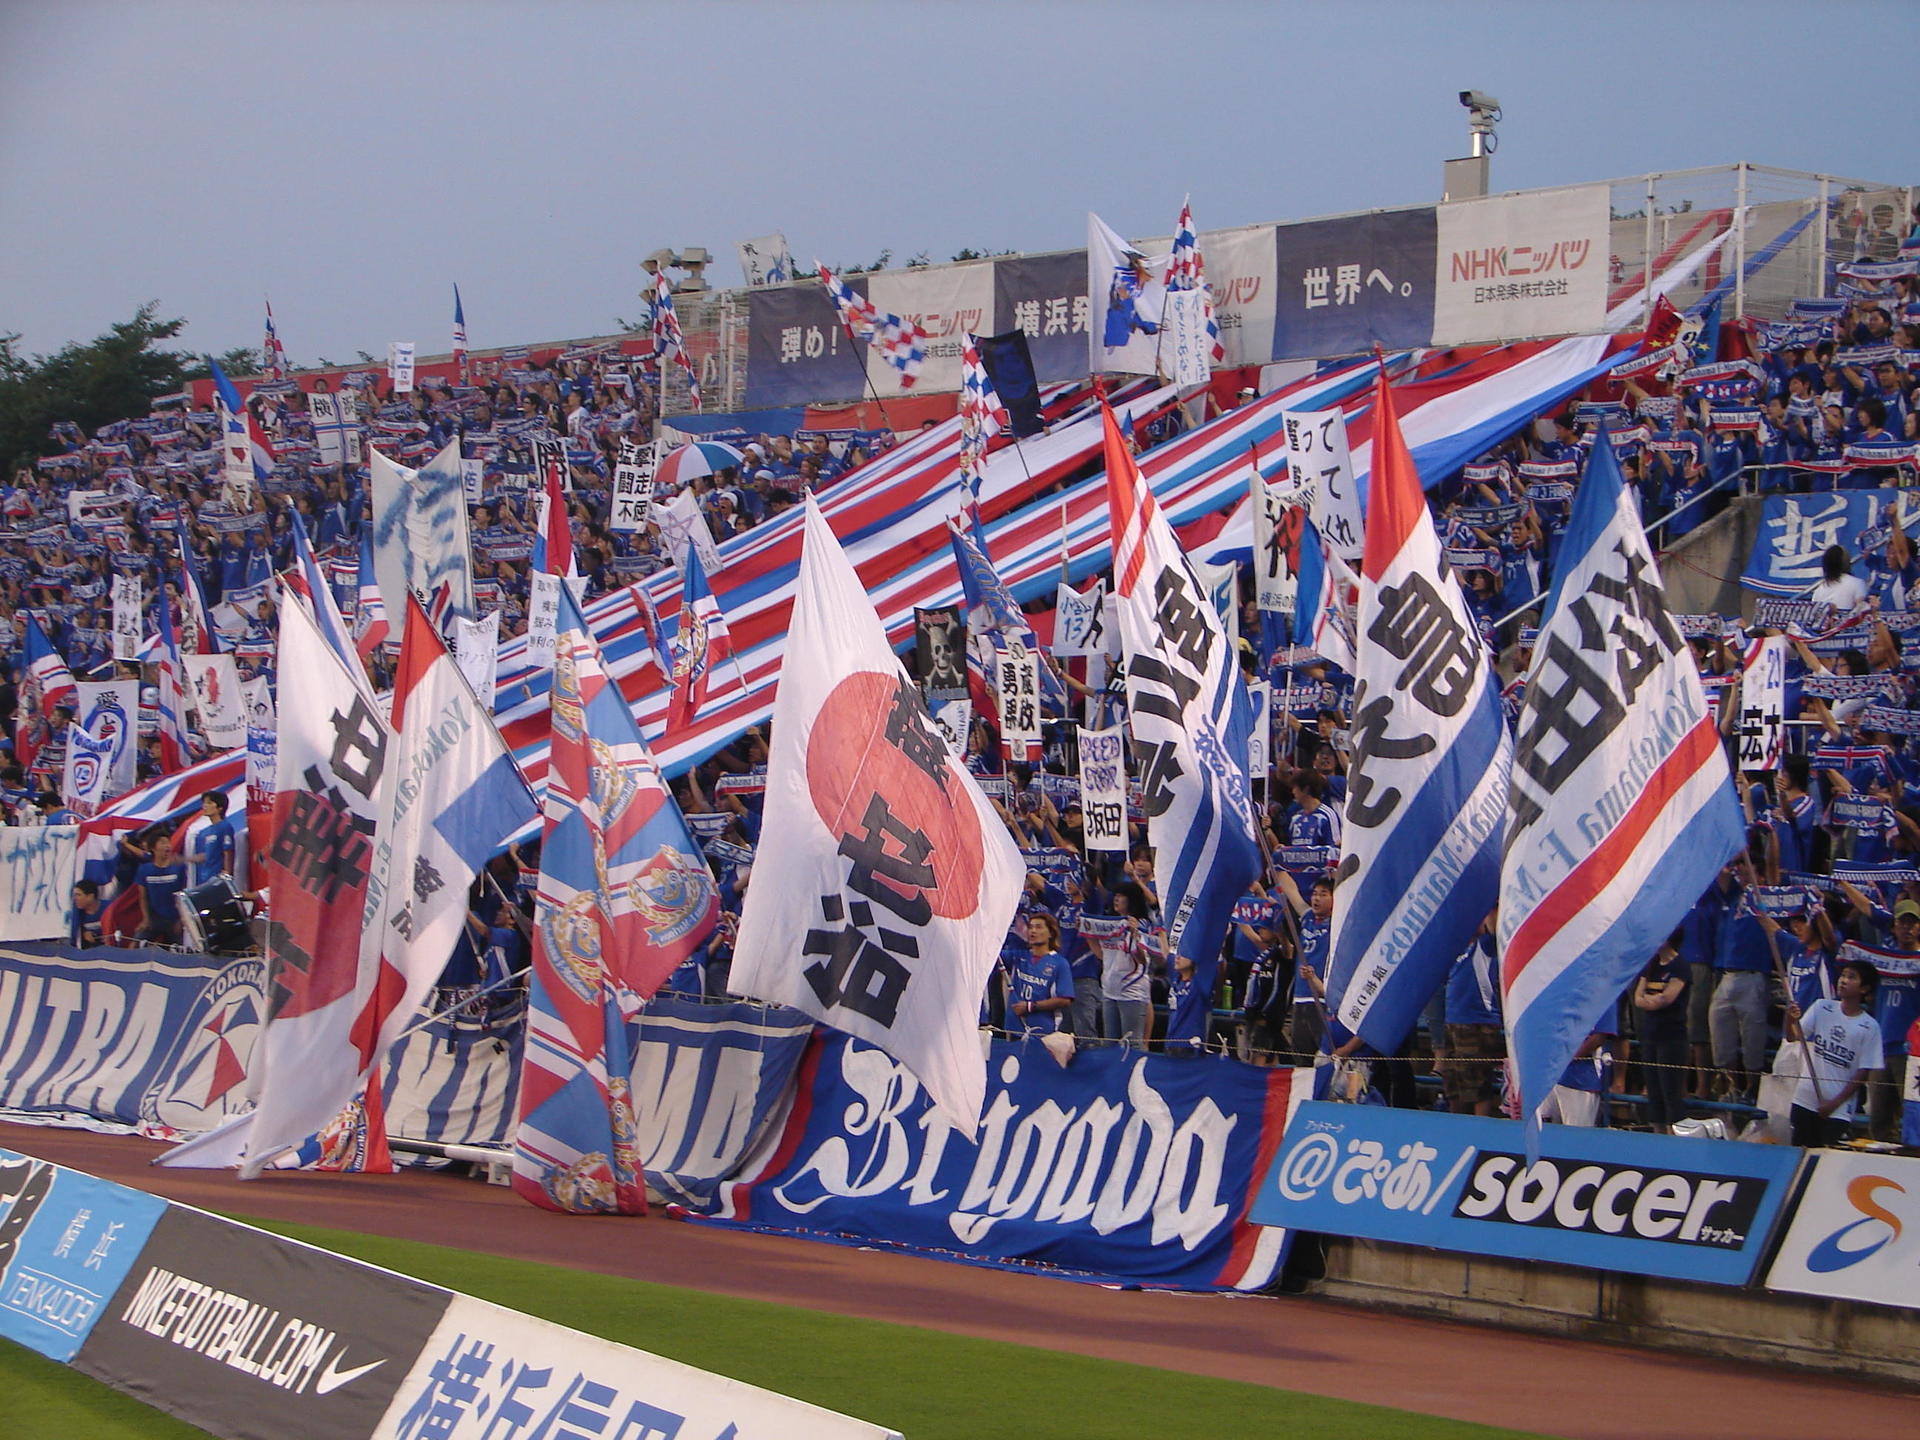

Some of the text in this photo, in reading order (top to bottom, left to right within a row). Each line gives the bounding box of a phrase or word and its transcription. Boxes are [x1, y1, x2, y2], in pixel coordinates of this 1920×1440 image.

[1451, 239, 1590, 283] NHKニッパツ
[1211, 275, 1261, 309] ッパツ
[1303, 264, 1412, 309] 世界へ。
[1474, 279, 1568, 303] 日本発条株式会社
[1457, 1154, 1739, 1242] soccer
[121, 1266, 337, 1395] NIKEFOOTBALL.COM
